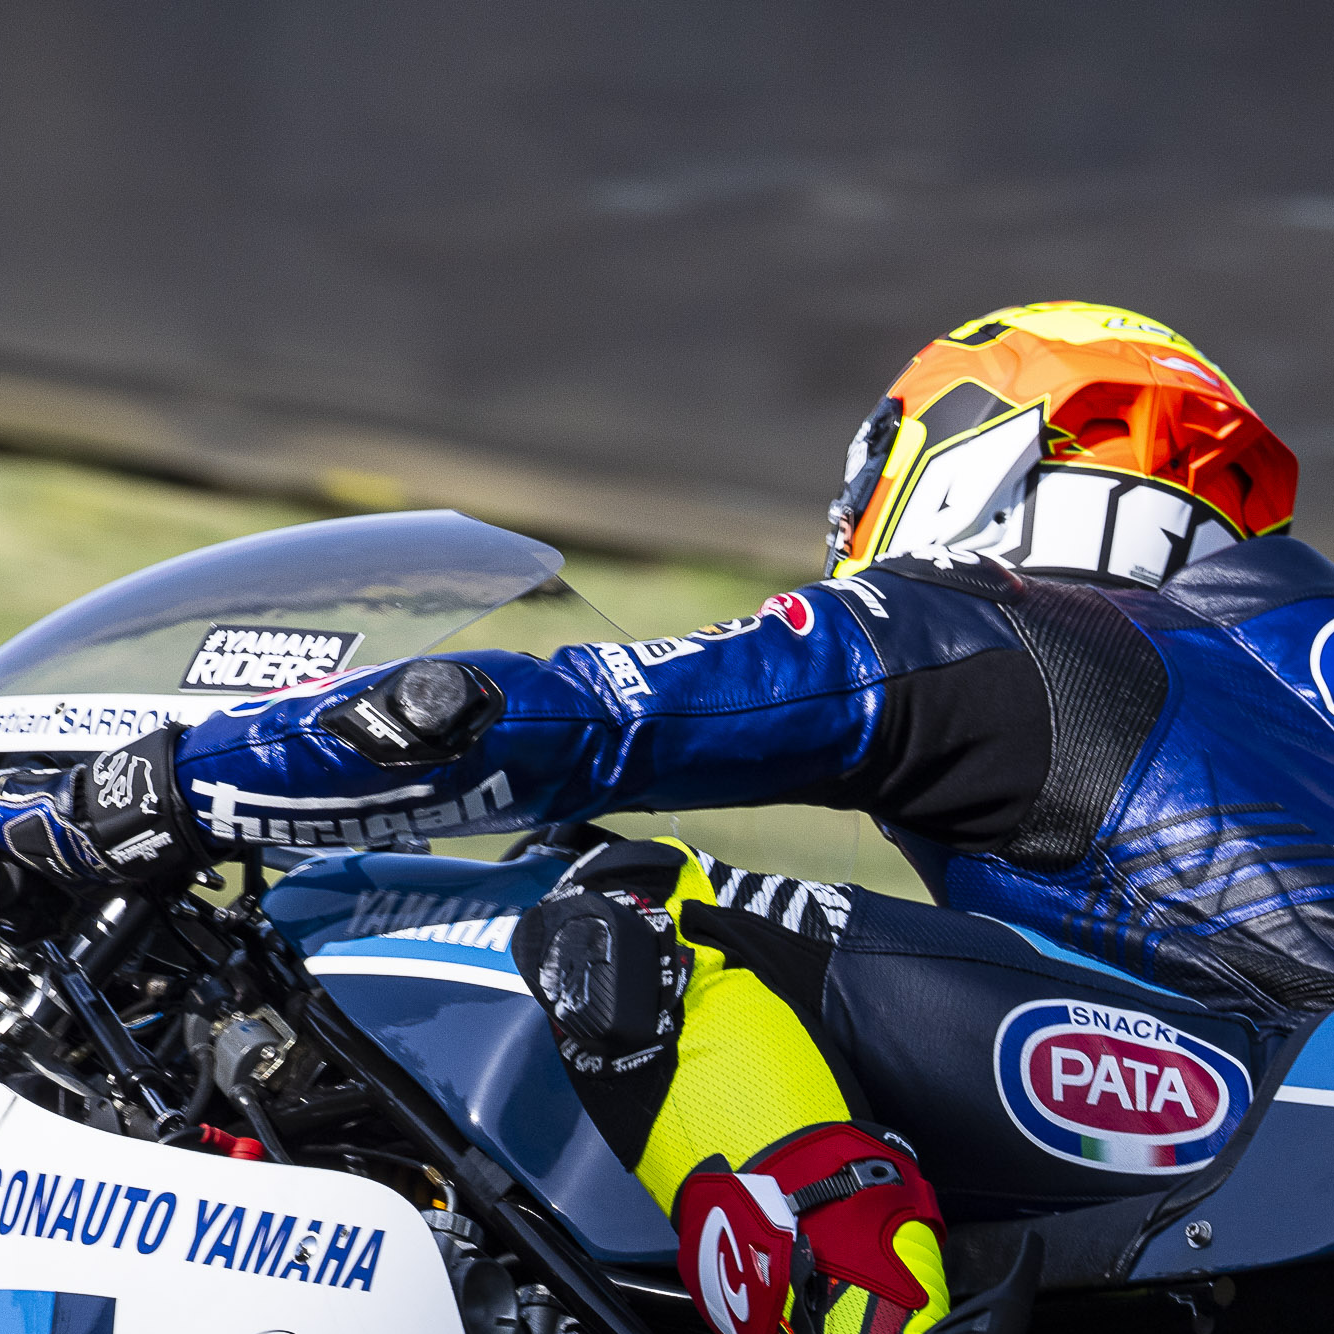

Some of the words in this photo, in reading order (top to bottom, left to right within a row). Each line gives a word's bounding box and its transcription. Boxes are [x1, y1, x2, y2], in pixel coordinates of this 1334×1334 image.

[185, 650, 336, 688] RIDERS
[203, 629, 343, 660] #YAMAHA
[345, 889, 523, 953] YAMAHA
[1072, 1005, 1175, 1044] SNACK
[1051, 1045, 1198, 1119] PATA
[185, 1199, 388, 1292] YAMAHA
